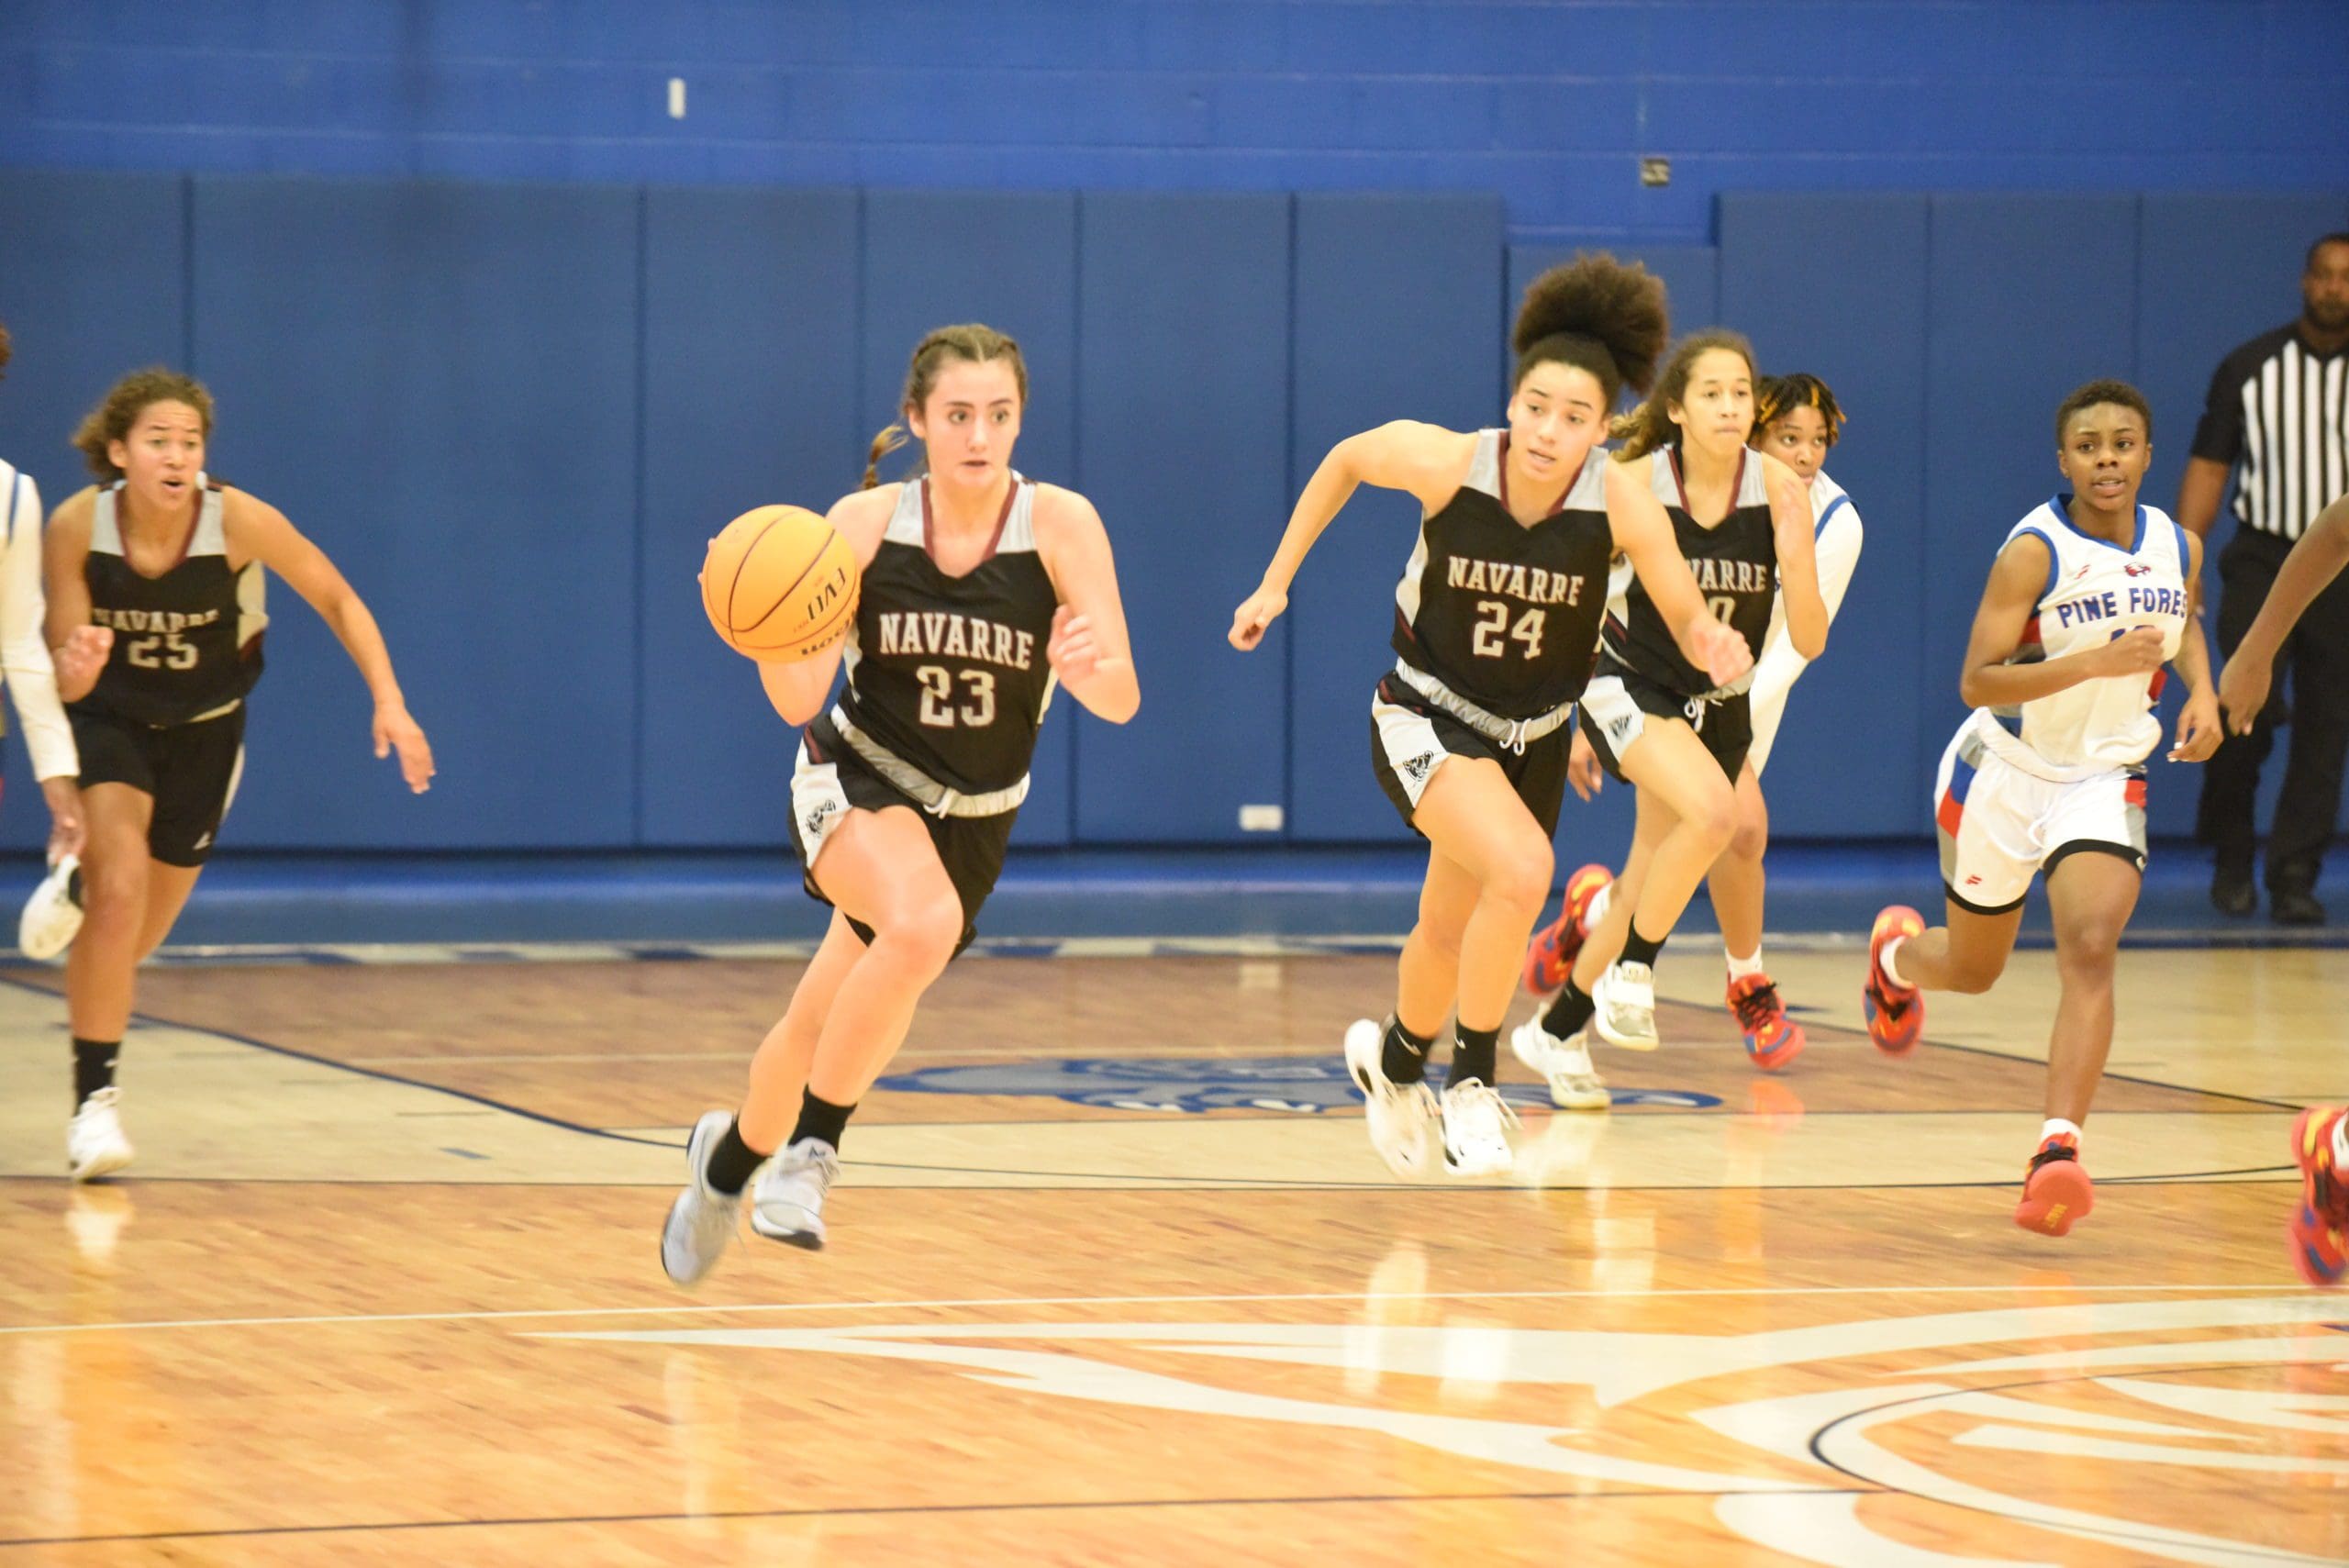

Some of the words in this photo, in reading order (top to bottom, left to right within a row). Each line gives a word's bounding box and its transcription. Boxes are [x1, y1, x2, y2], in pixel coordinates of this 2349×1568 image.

[1447, 555, 1585, 607] NAVARRE
[1686, 558, 1767, 593] VARRE
[1473, 600, 1546, 661] 24
[2055, 591, 2118, 629] PINE
[128, 633, 198, 670] 25
[879, 612, 1034, 672] NAVARRE
[916, 665, 996, 728] 23
